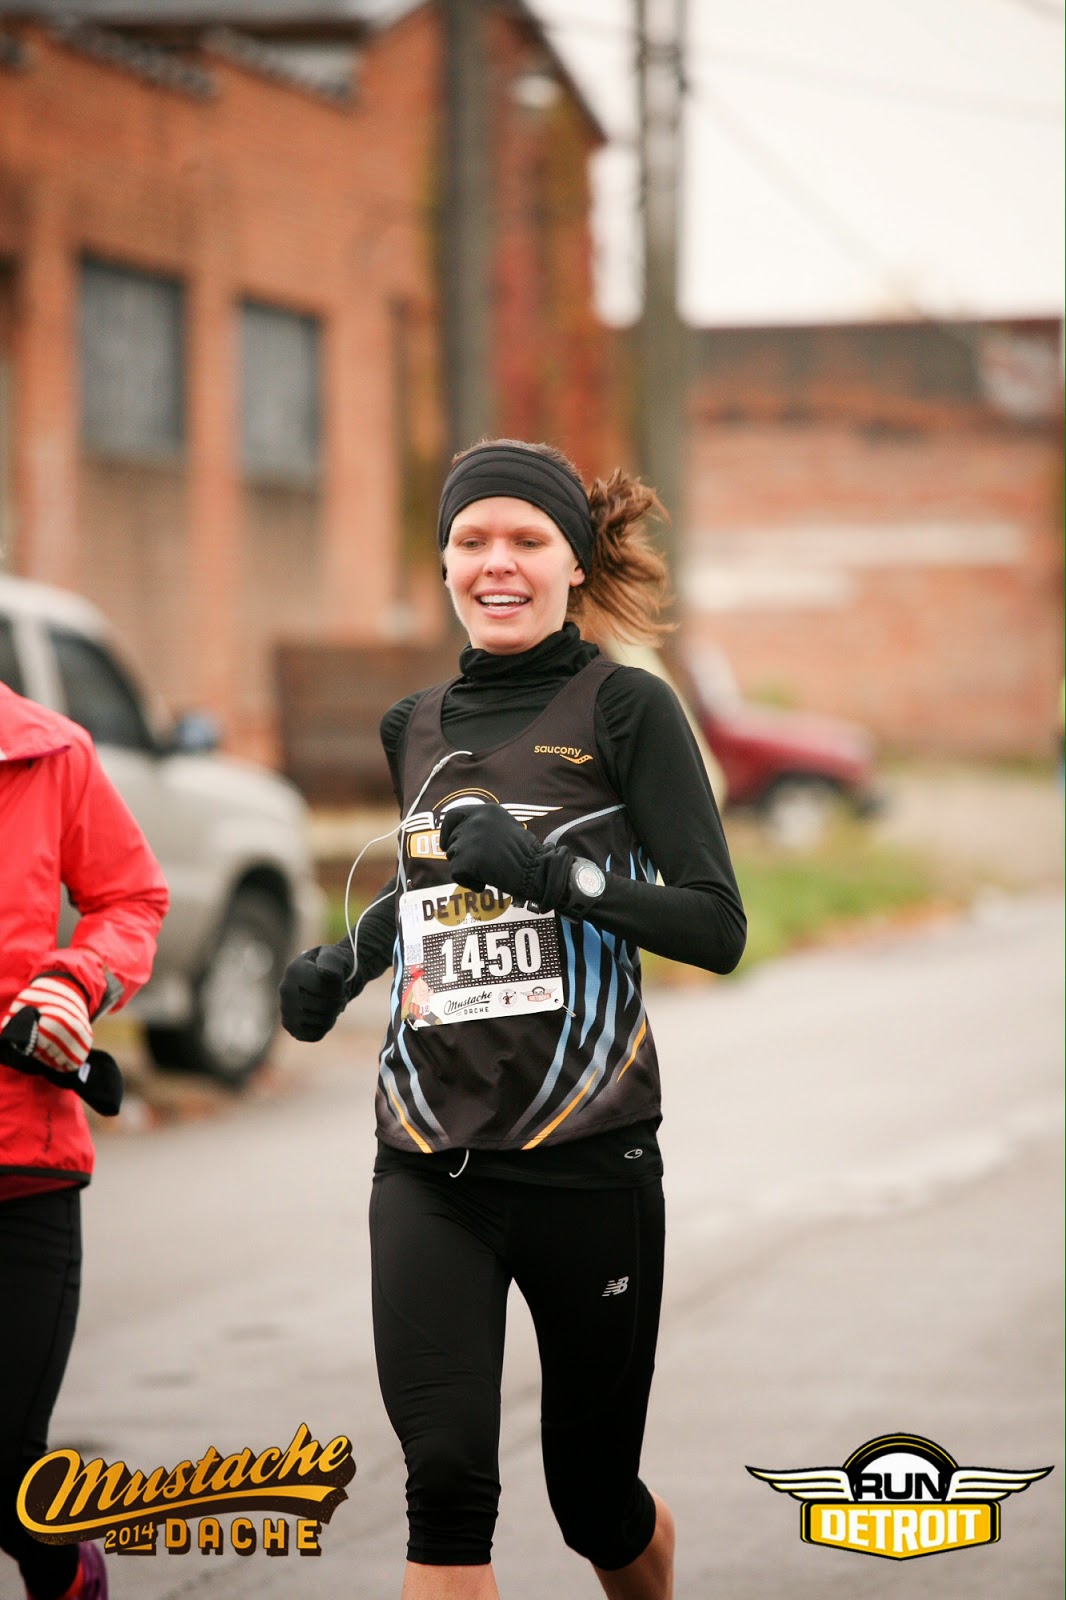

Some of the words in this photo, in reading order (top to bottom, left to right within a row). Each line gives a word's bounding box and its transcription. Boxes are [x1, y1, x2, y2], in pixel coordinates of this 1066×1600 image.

[533, 744, 582, 758] saucony
[421, 889, 505, 921] DETROI
[441, 927, 542, 984] 1450
[444, 990, 493, 1016] Mustache
[464, 1006, 490, 1015] DACHE
